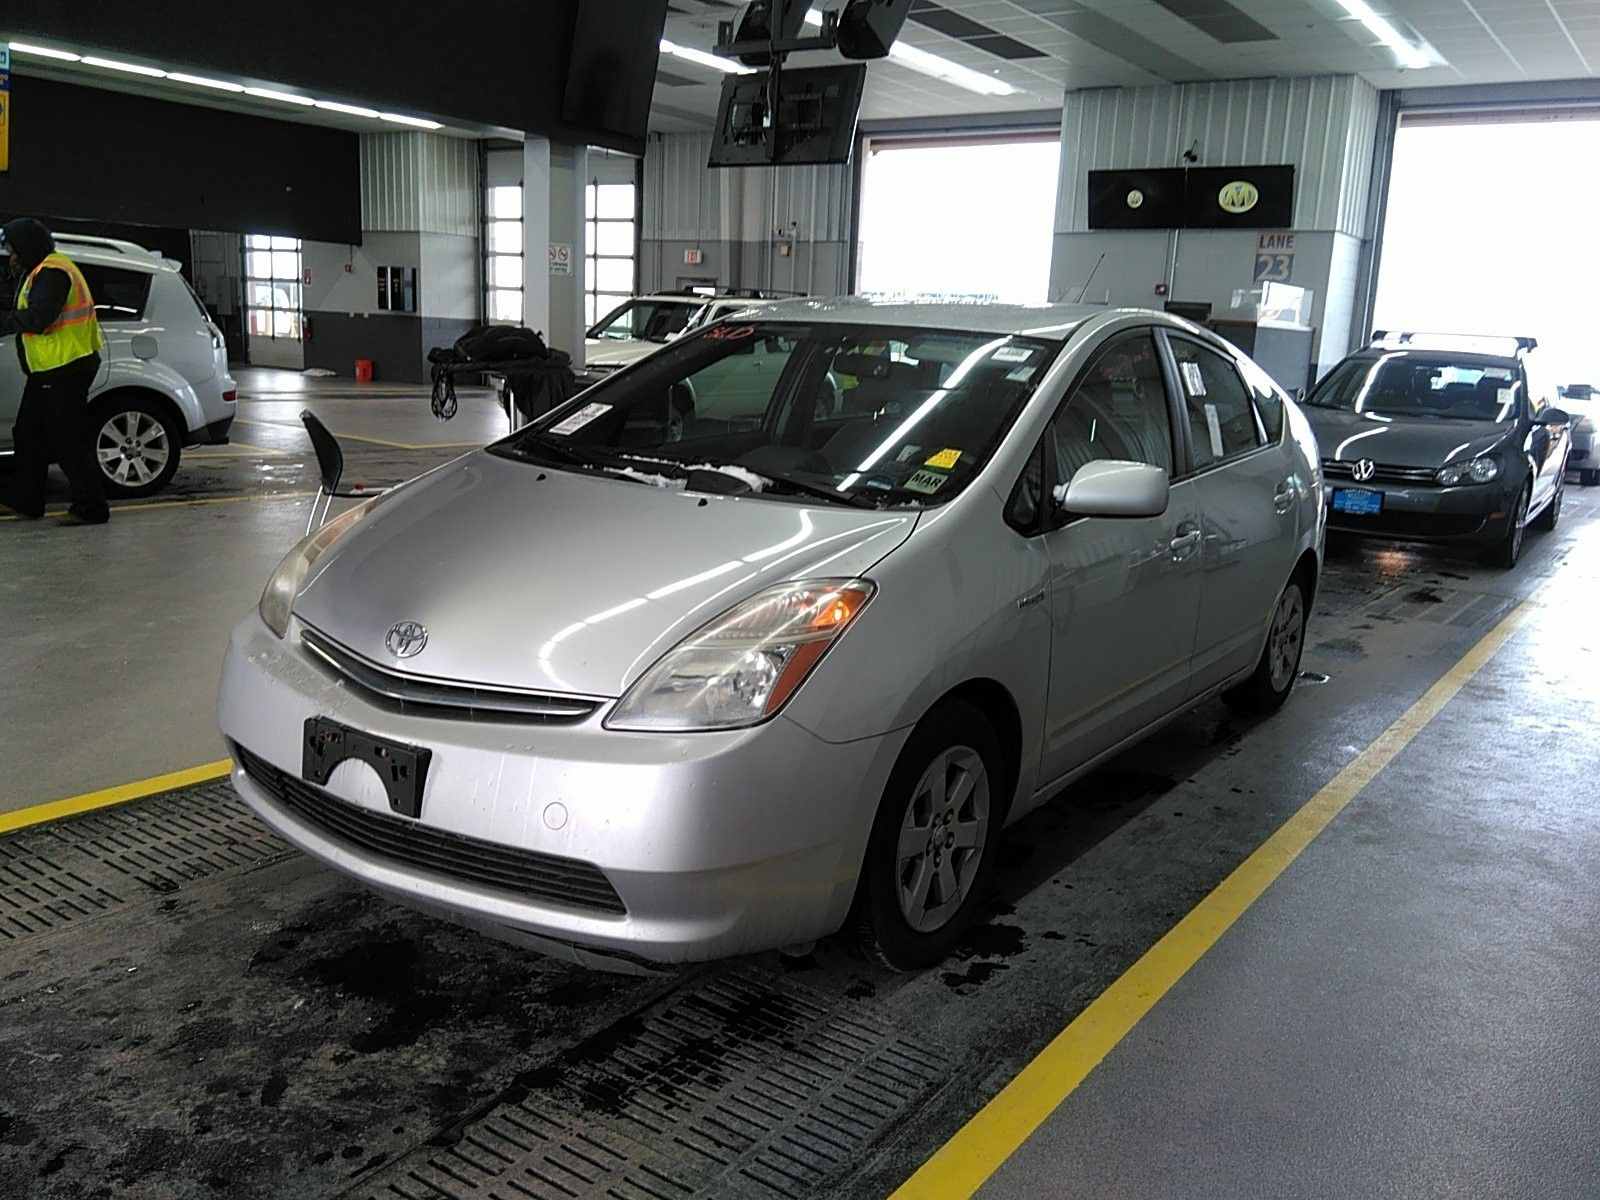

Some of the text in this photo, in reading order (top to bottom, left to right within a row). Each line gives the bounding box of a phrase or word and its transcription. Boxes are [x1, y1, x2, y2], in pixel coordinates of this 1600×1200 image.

[1259, 235, 1294, 248] LANE
[1255, 255, 1290, 281] 23
[911, 474, 942, 489] MAR
